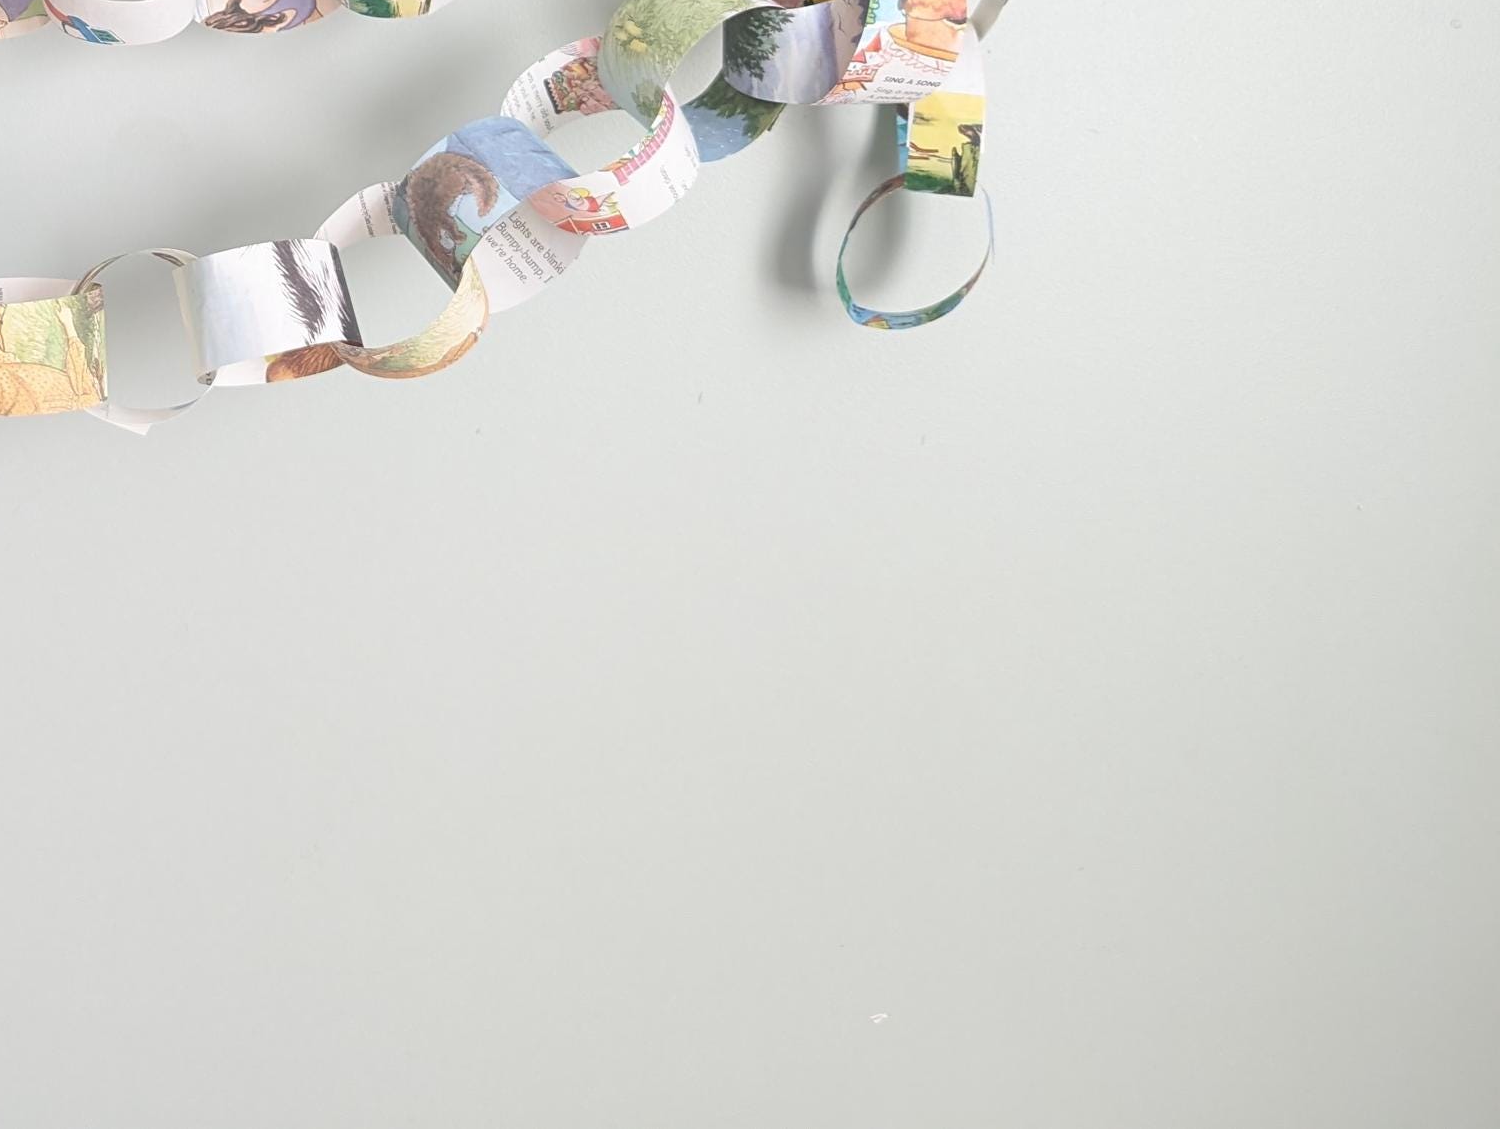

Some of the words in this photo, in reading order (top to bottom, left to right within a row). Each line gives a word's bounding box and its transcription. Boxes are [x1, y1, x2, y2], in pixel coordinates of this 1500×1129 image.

[883, 75, 905, 84] SING
[915, 79, 942, 88] SONG
[495, 221, 545, 280] Bumpy-bump,
[508, 210, 533, 239] Lights
[530, 237, 545, 253] are
[485, 235, 507, 258] we're
[504, 255, 528, 284] home.
